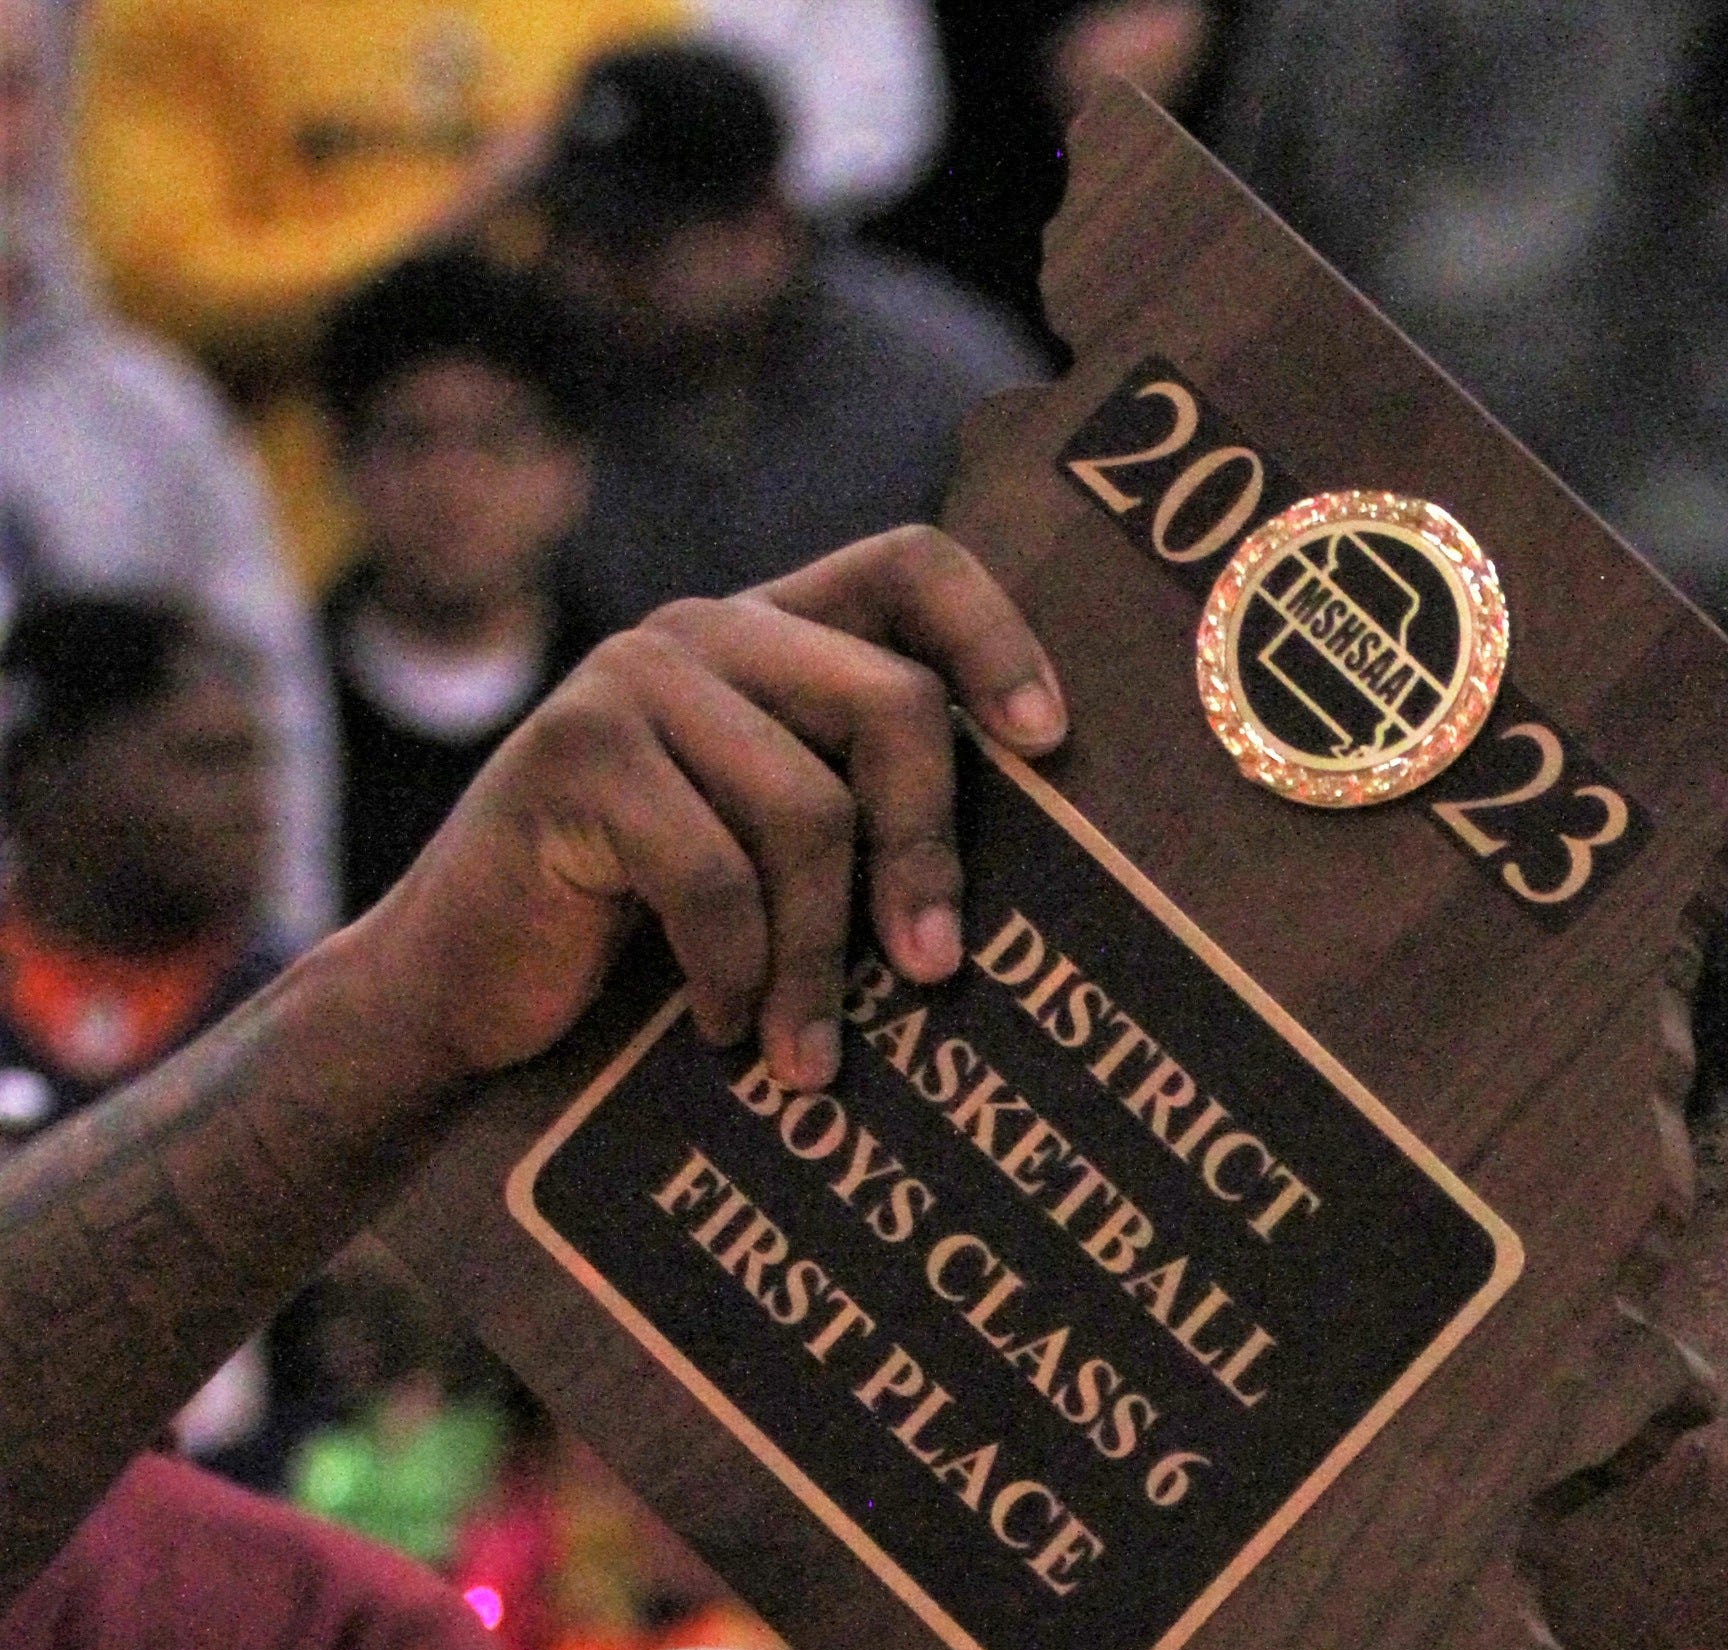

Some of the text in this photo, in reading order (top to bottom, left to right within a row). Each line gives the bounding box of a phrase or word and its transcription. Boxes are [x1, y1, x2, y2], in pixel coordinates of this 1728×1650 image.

[1067, 380, 1629, 904] 20 23
[1285, 576, 1416, 705] MSHSAA
[729, 1058, 1213, 1508] BOYS CLASS 6
[845, 956, 1277, 1409] BASKETBALL
[972, 908, 1321, 1243] DISTRICT
[652, 1149, 1105, 1596] FIRST PLACE
